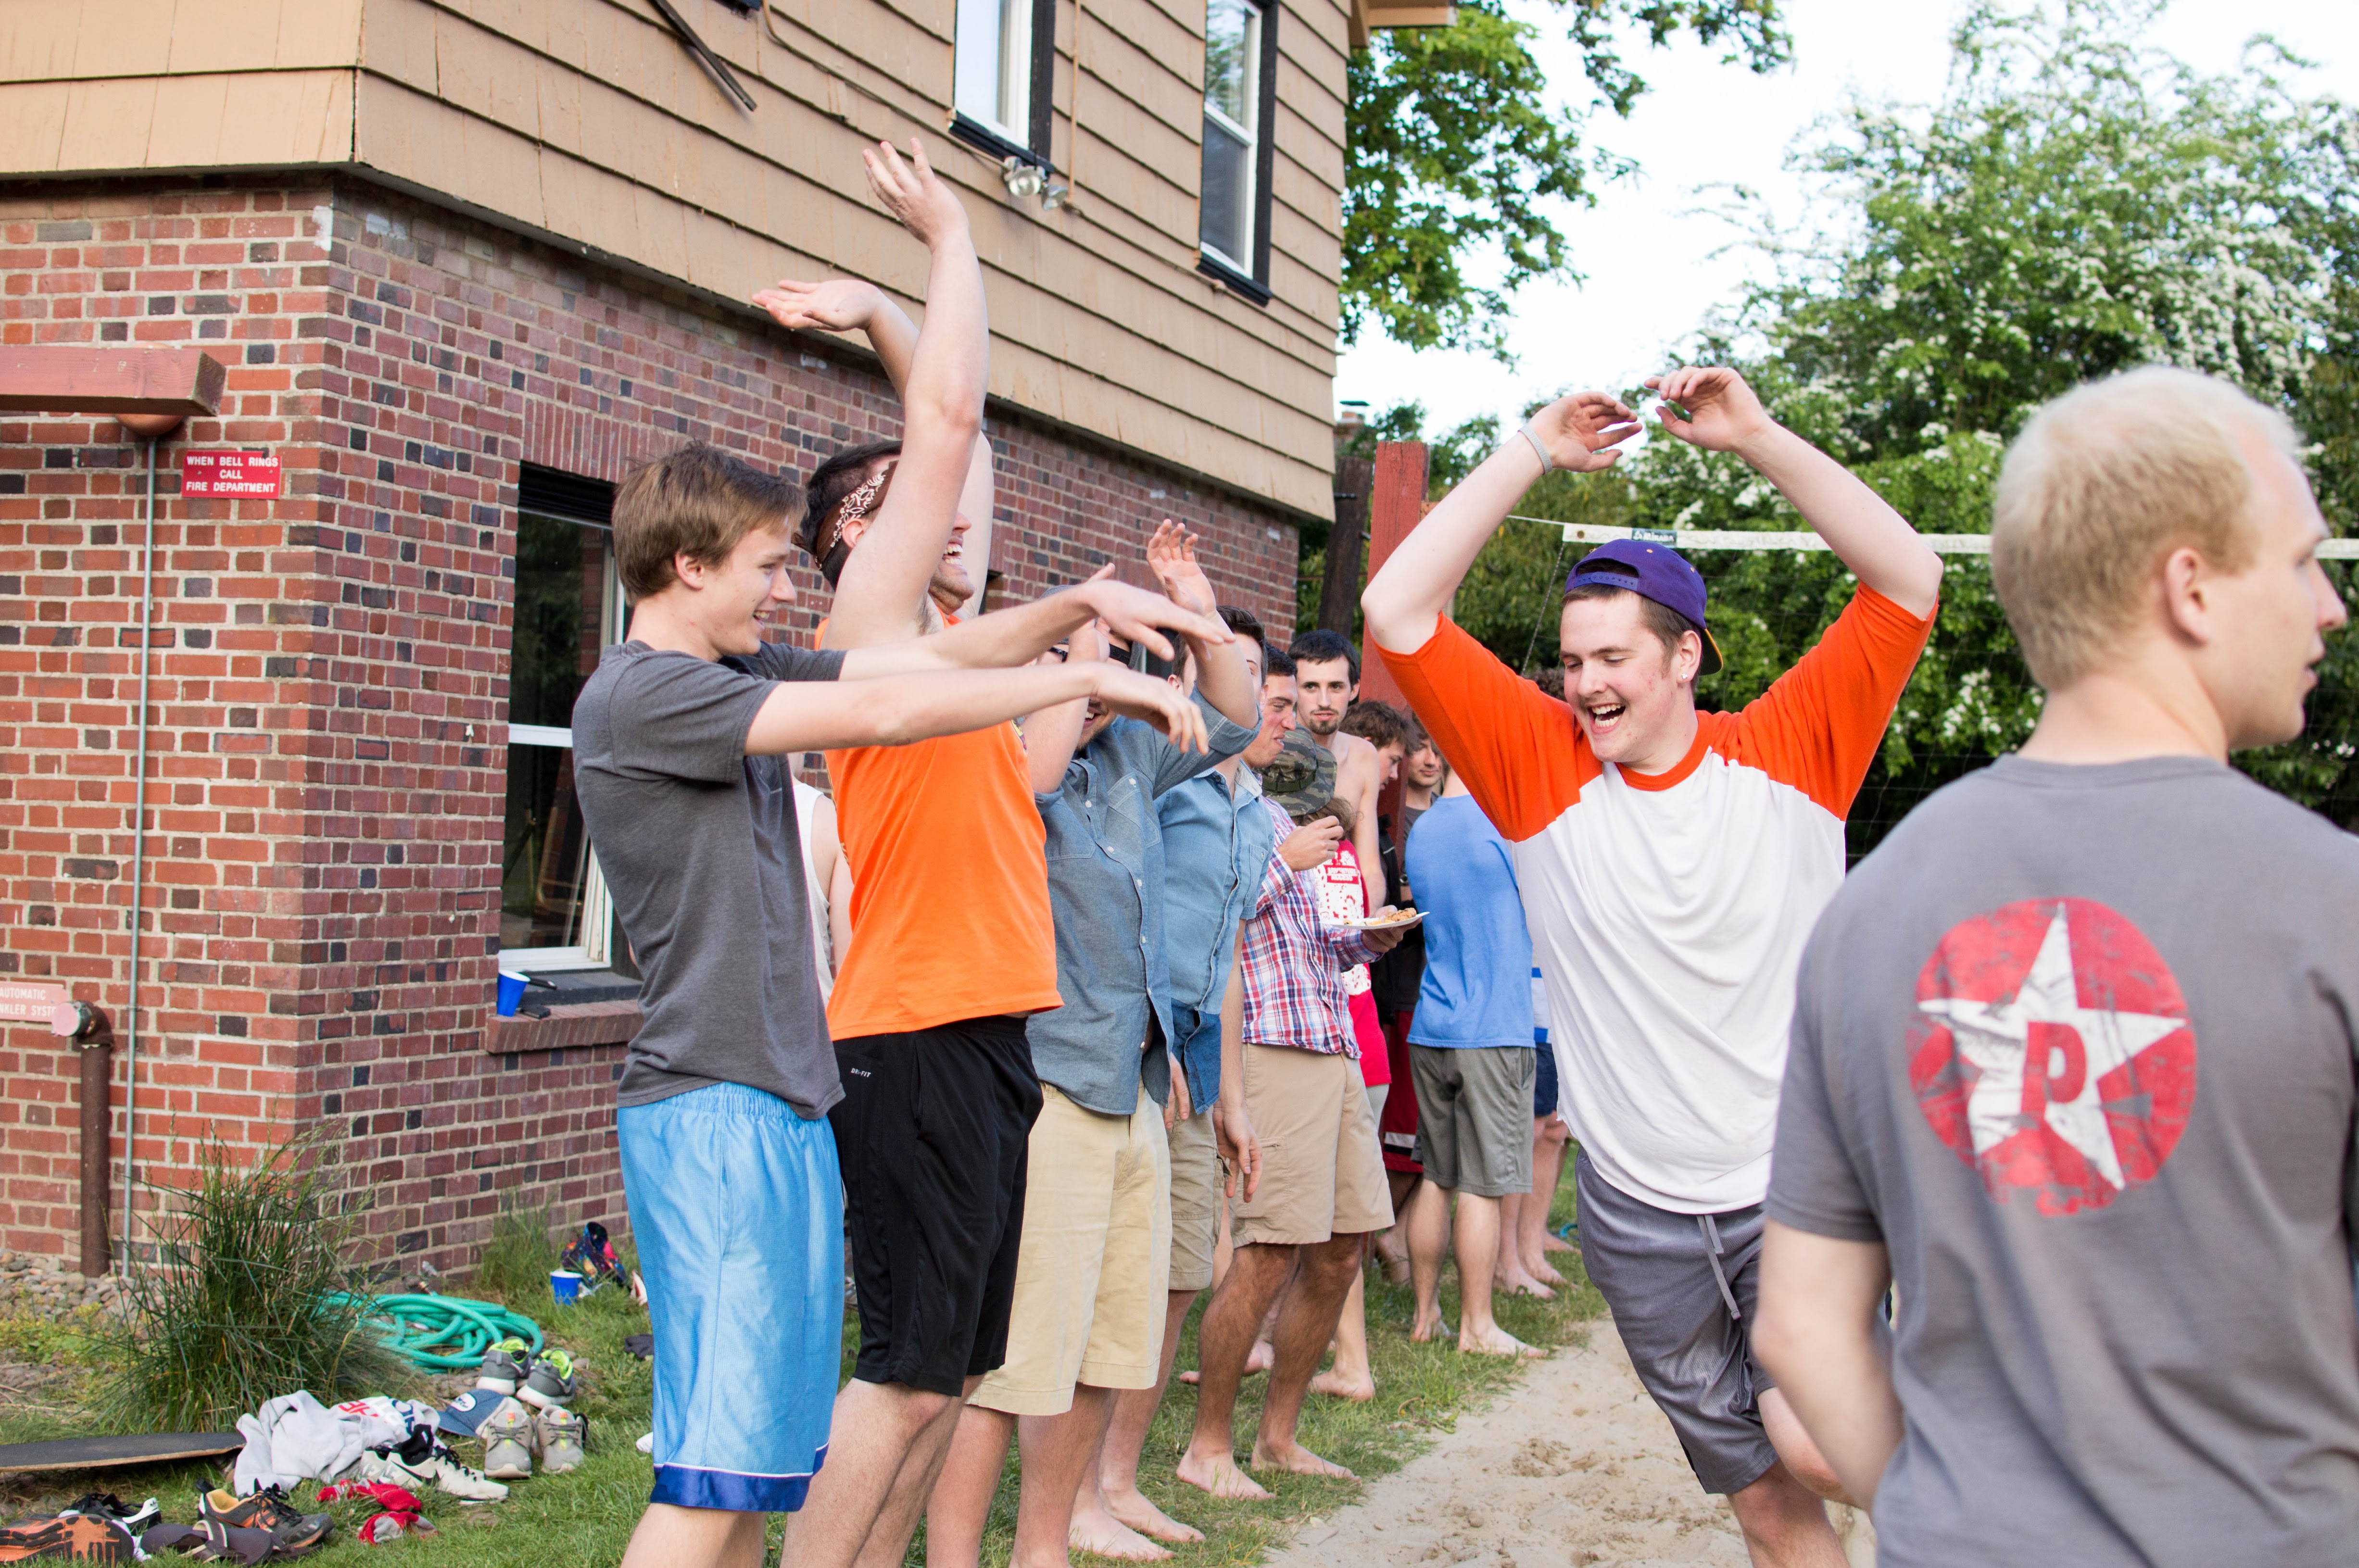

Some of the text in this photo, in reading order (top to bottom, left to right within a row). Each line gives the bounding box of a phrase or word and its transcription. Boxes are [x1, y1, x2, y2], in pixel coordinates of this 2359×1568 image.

[187, 456, 278, 467] WHEN BELL RINGS
[219, 469, 242, 479] CALL
[186, 482, 275, 492] FIRE DEPARTMENT
[0, 987, 46, 1001] AUTOMATIC
[851, 1067, 871, 1078] DRI-FIT
